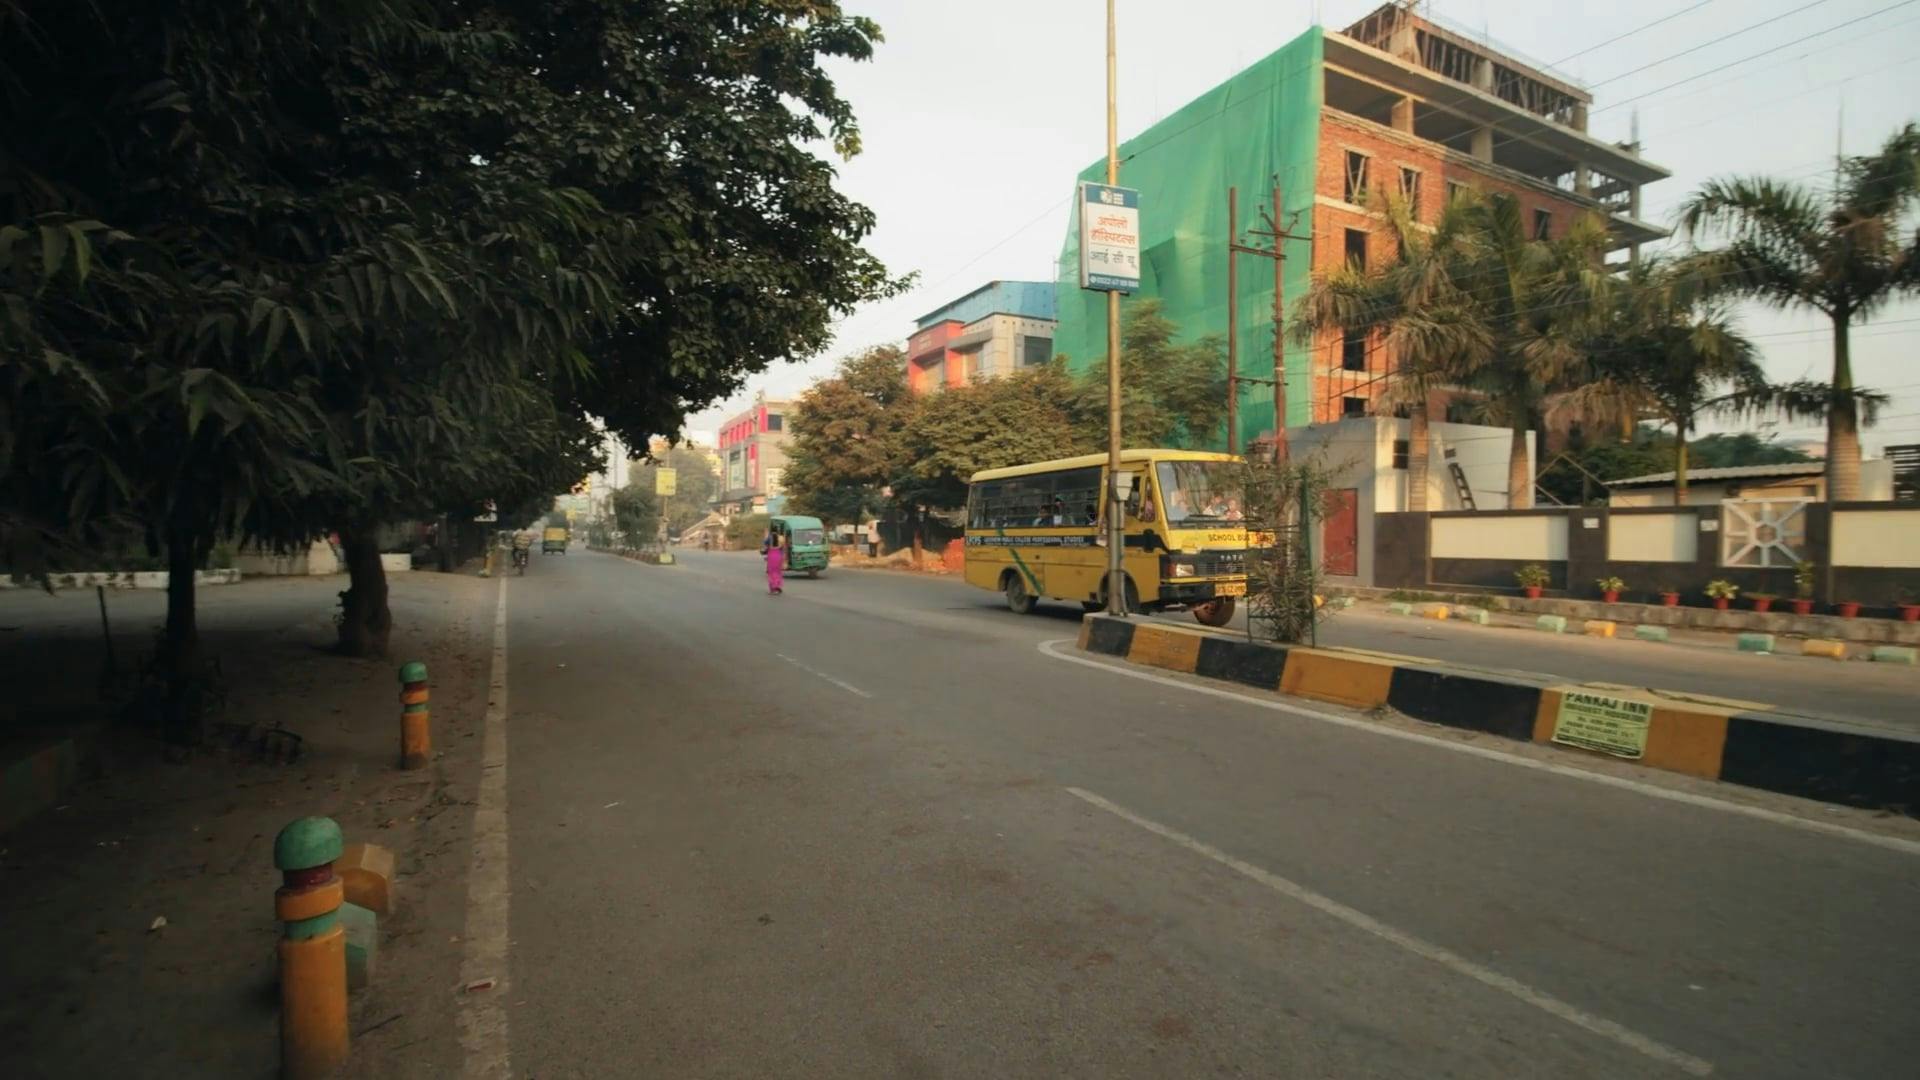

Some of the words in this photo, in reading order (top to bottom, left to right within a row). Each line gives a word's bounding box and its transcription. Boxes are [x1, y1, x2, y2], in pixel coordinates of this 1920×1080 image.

[1208, 533, 1236, 541] SCHOOL
[1566, 692, 1618, 709] PANKAJ
[1623, 701, 1649, 715] INN
